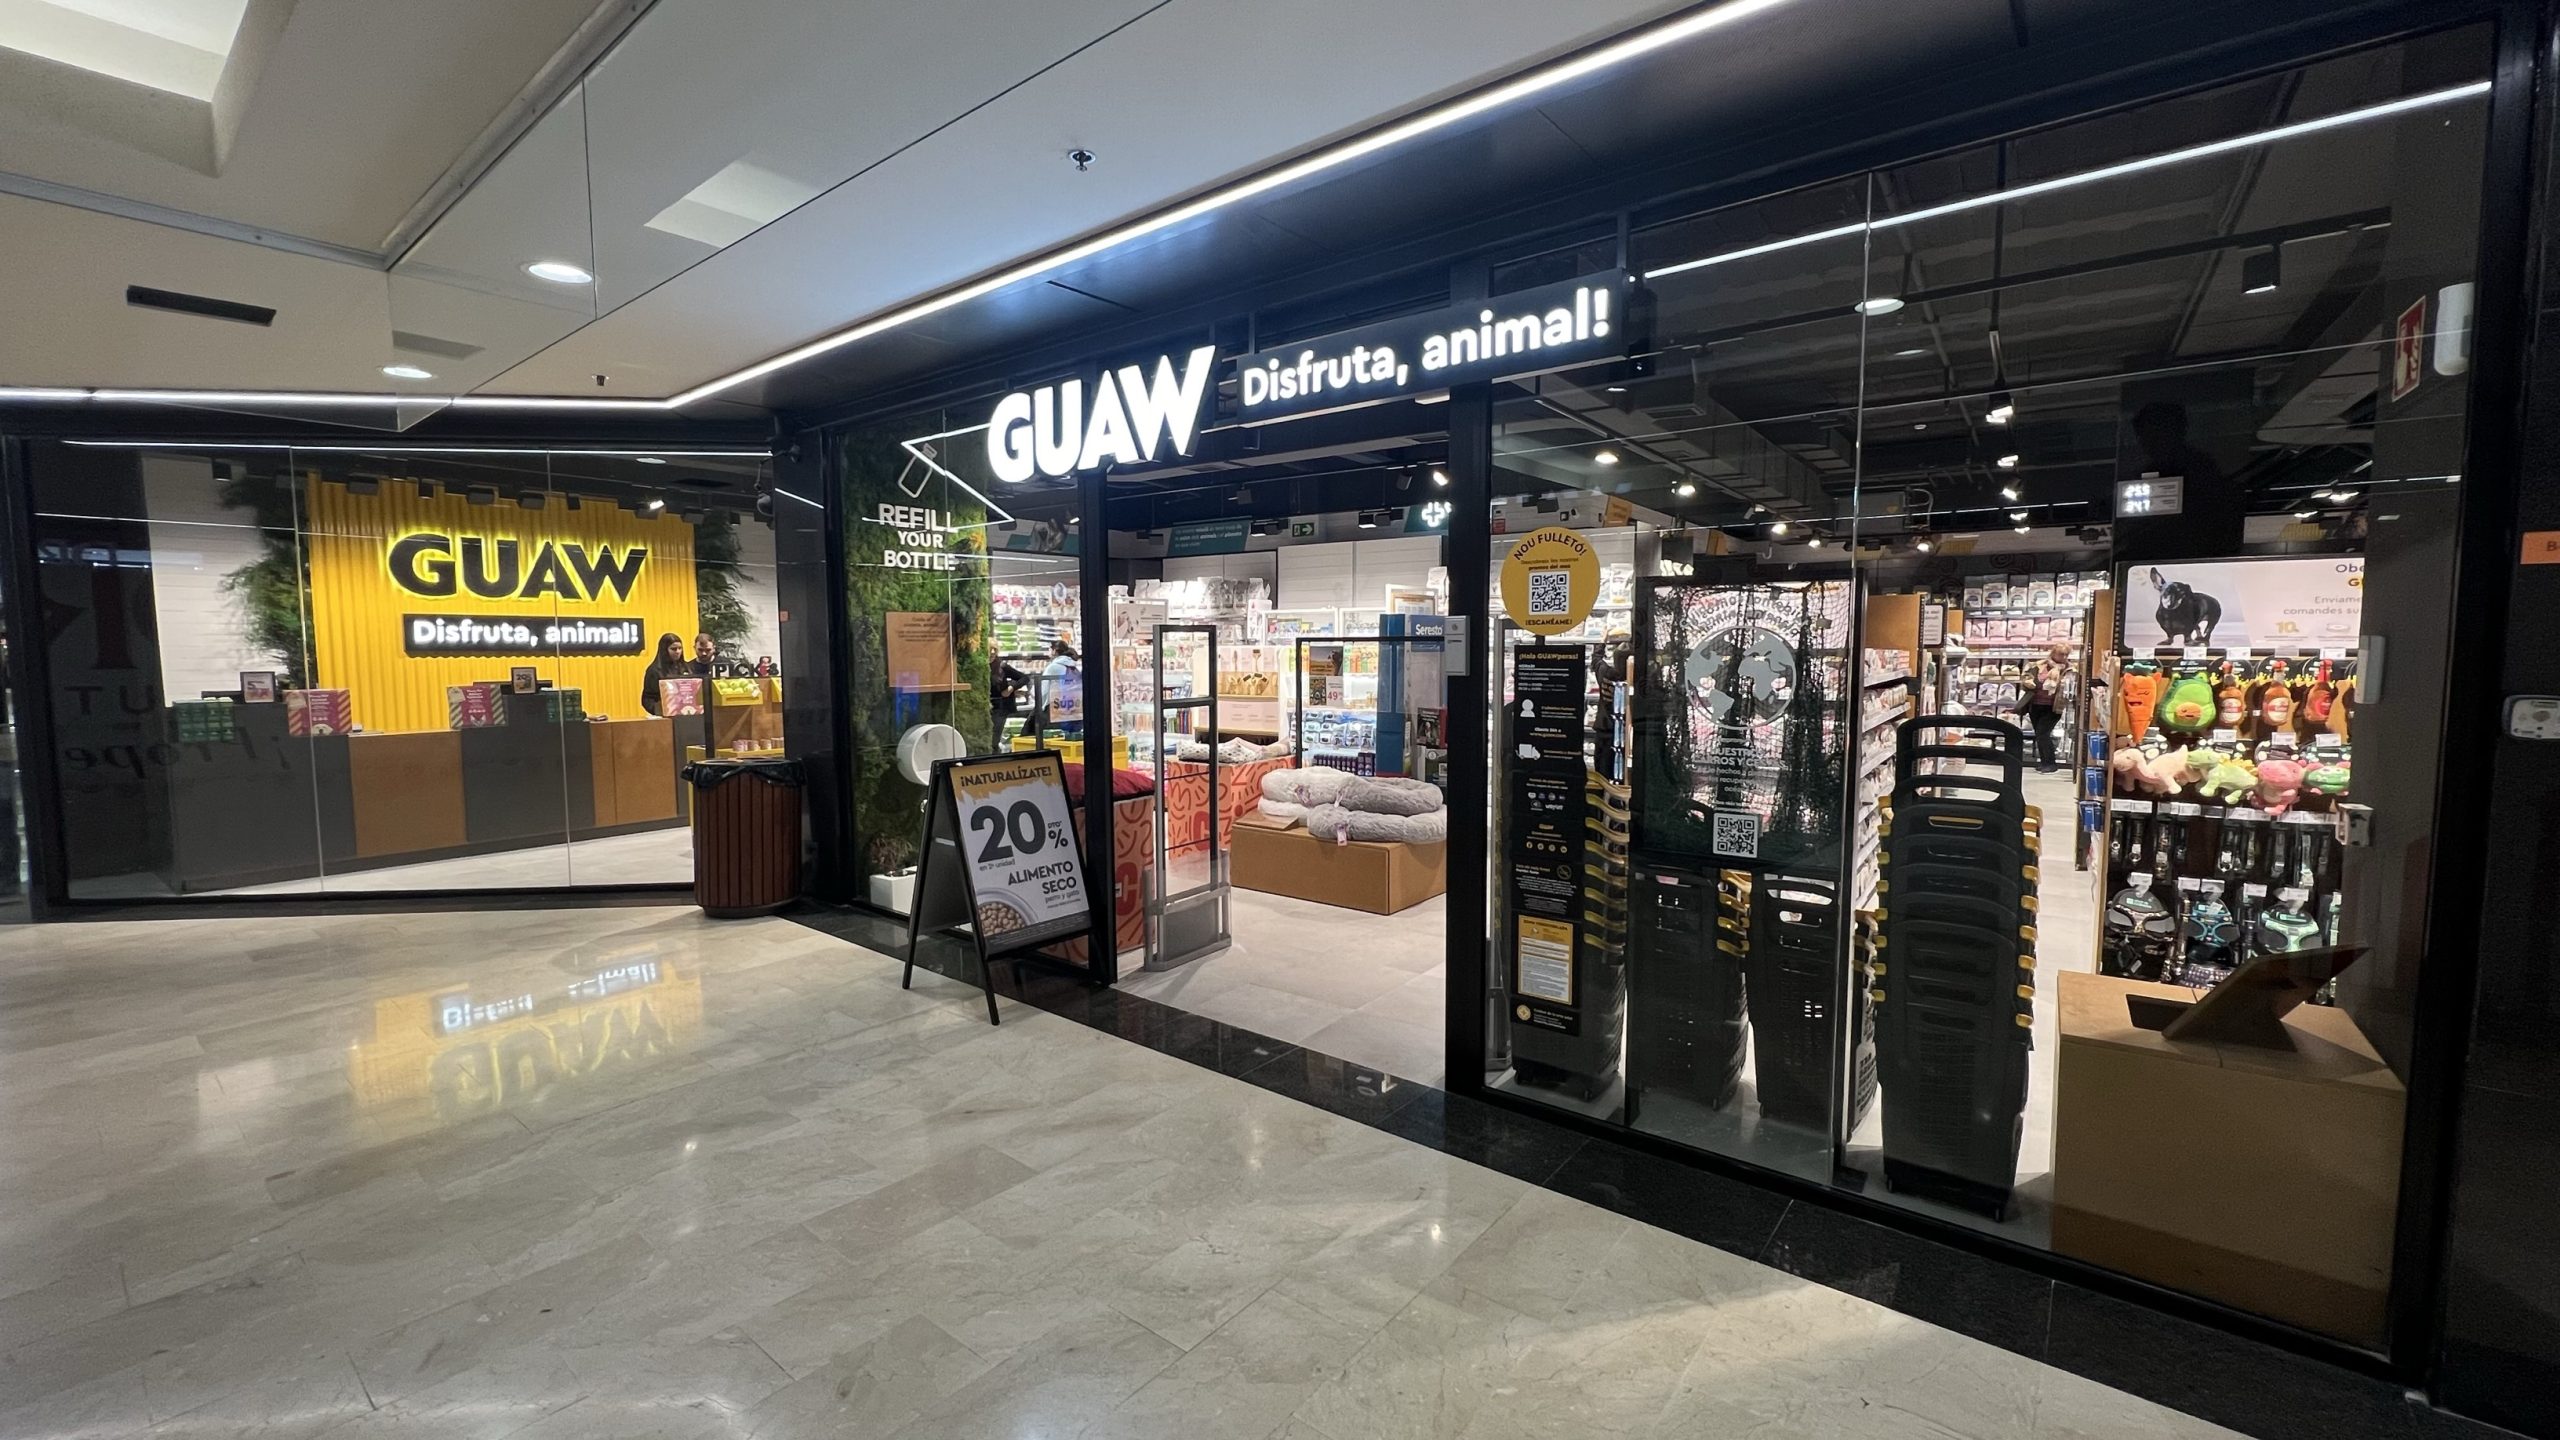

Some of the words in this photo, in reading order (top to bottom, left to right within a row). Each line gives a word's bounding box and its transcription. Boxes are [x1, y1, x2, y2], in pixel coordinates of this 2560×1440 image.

[1242, 343, 1409, 408] Disfruta,
[1423, 287, 1610, 371] animal!
[987, 345, 1217, 484] GUAW
[878, 503, 958, 533] REFILL
[897, 530, 944, 549] YOUR
[1514, 539, 1536, 560] NOU
[1537, 532, 1588, 556] FULLETÓ!
[389, 533, 648, 603] GUAW
[884, 550, 956, 571] BOTTLE
[412, 617, 539, 648] Disfruta,
[545, 620, 639, 644] animal!
[960, 766, 1052, 787] ¡NATURALÍZATE!
[970, 800, 1046, 864] 20
[1048, 829, 1069, 849] %
[1008, 861, 1074, 886] ALIMENTO
[1042, 876, 1077, 895] SECO
